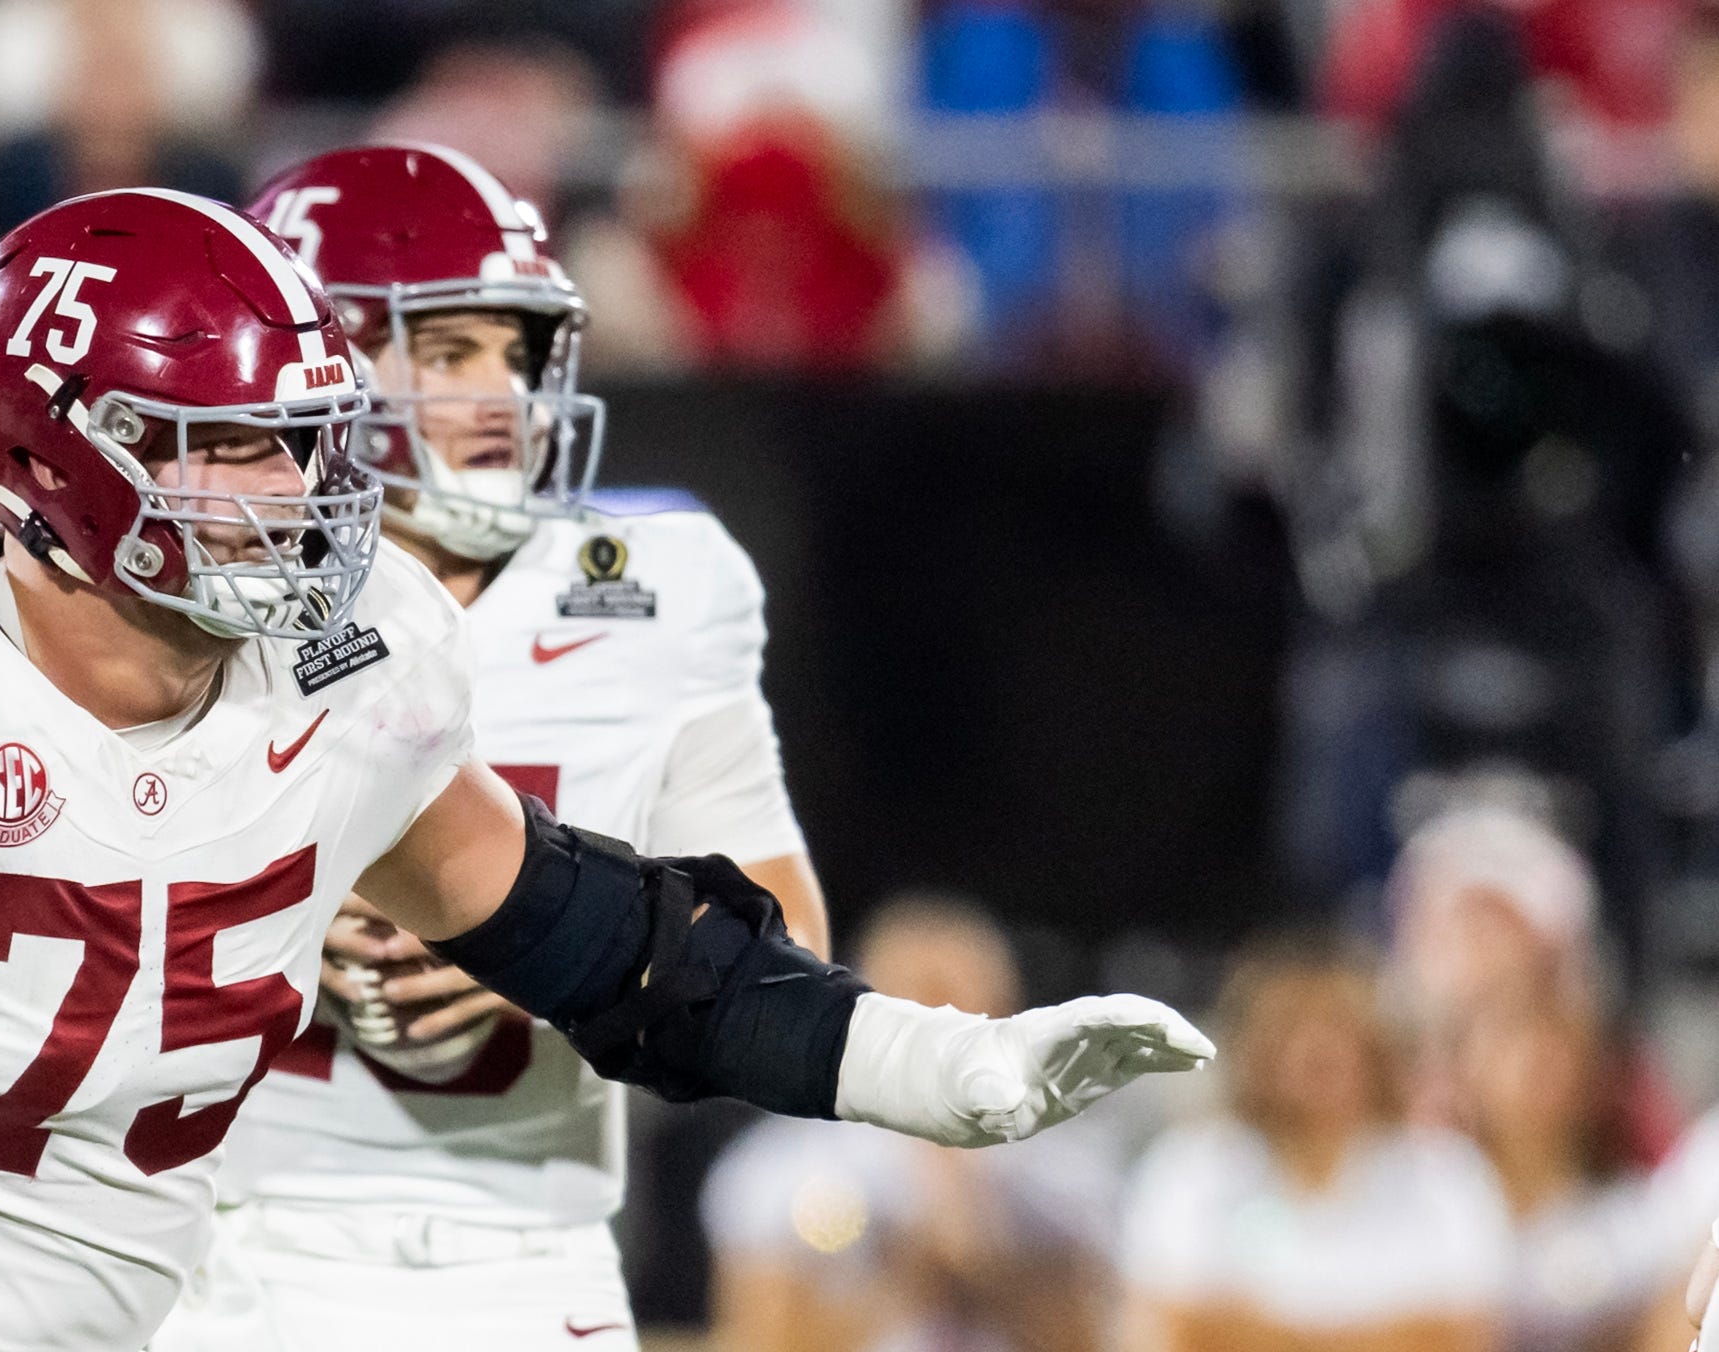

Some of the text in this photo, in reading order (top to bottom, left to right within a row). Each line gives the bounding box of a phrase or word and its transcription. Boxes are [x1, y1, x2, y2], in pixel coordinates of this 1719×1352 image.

[6, 256, 118, 366] 75
[303, 363, 345, 390] BAMA
[296, 631, 379, 680] FIRST ROUND
[301, 626, 356, 661] PLAYOFF
